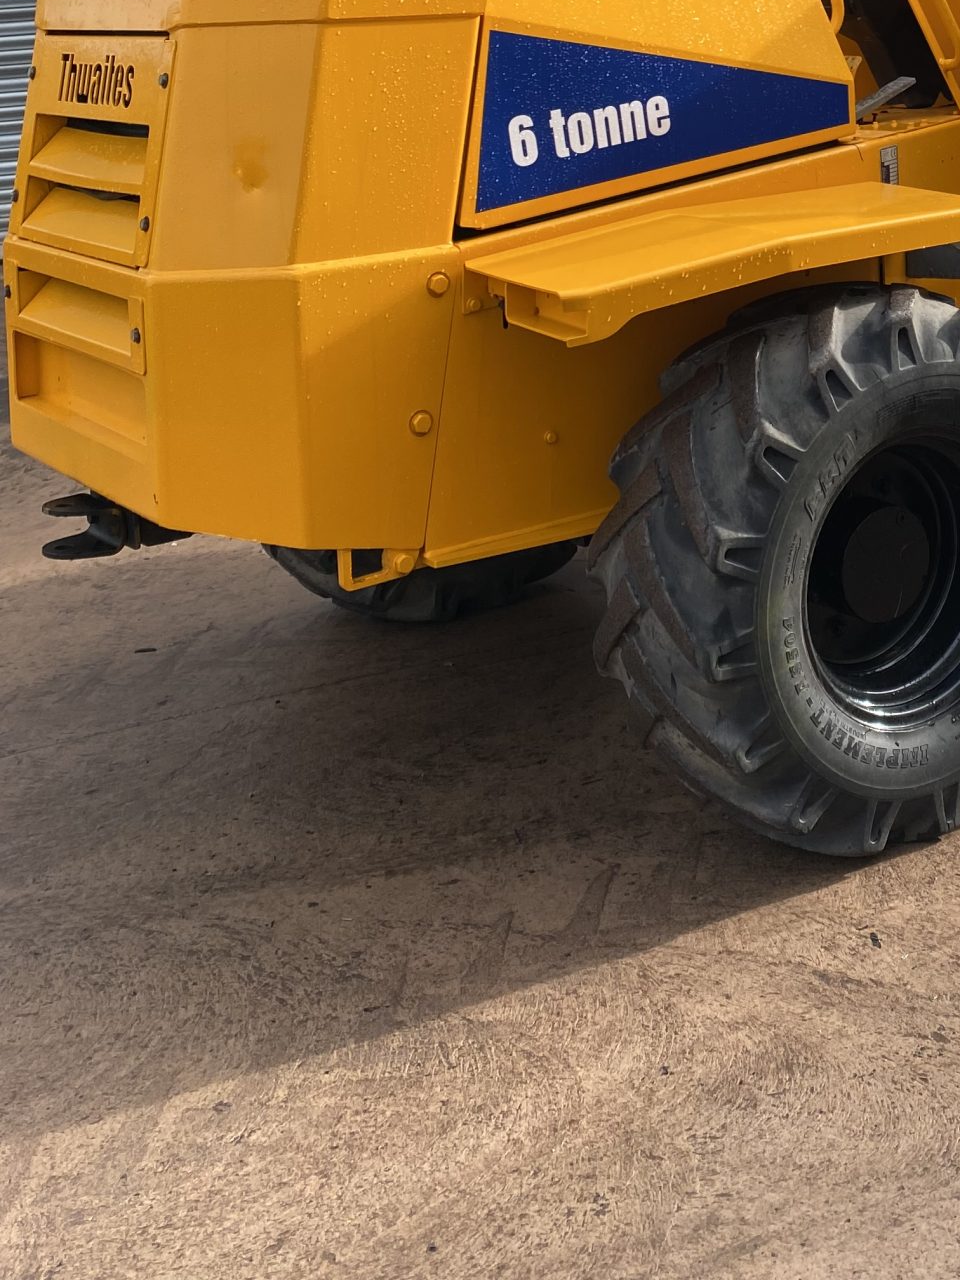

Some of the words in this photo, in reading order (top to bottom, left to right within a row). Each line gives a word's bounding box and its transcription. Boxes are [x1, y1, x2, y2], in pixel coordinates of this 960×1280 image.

[57, 53, 135, 109] Thwaites
[508, 114, 539, 167] 6
[549, 95, 671, 158] tonne
[810, 707, 929, 770] IMPLEMENT
